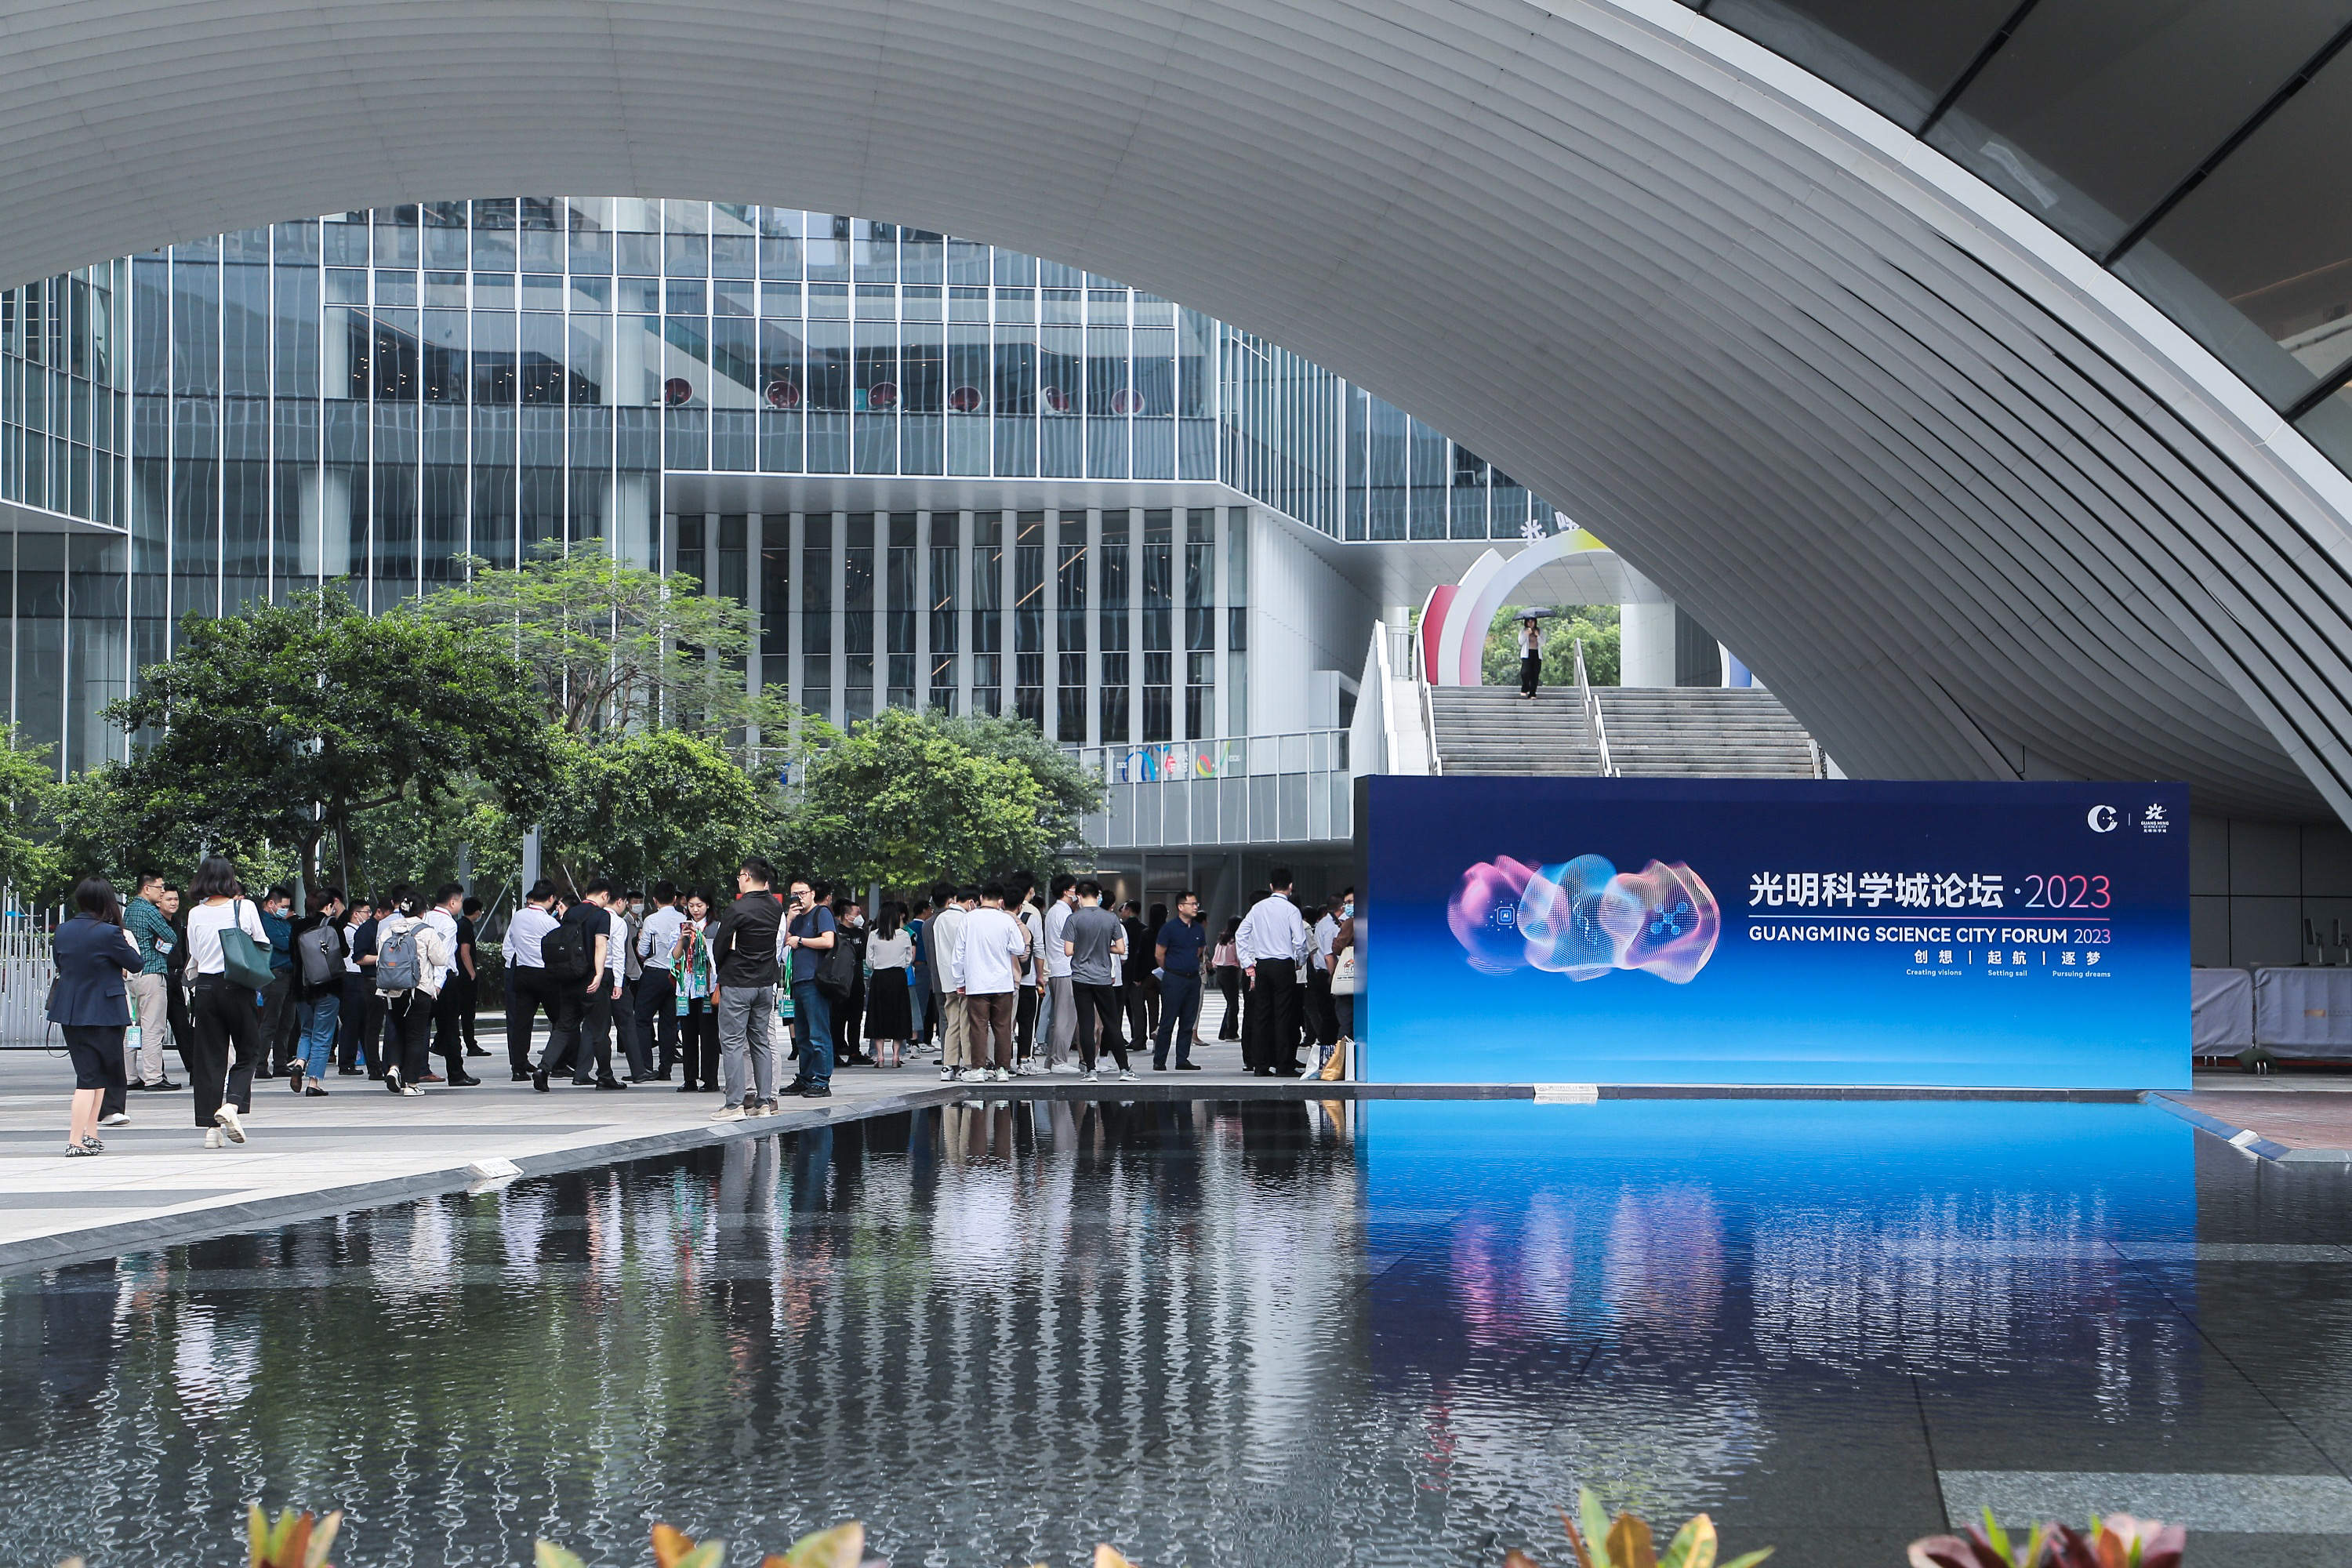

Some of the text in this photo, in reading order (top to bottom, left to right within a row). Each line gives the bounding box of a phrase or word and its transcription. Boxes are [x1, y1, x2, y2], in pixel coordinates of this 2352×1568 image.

[1749, 925, 2111, 944] GUANGMING SCIENCE CITY FORUM 2023
